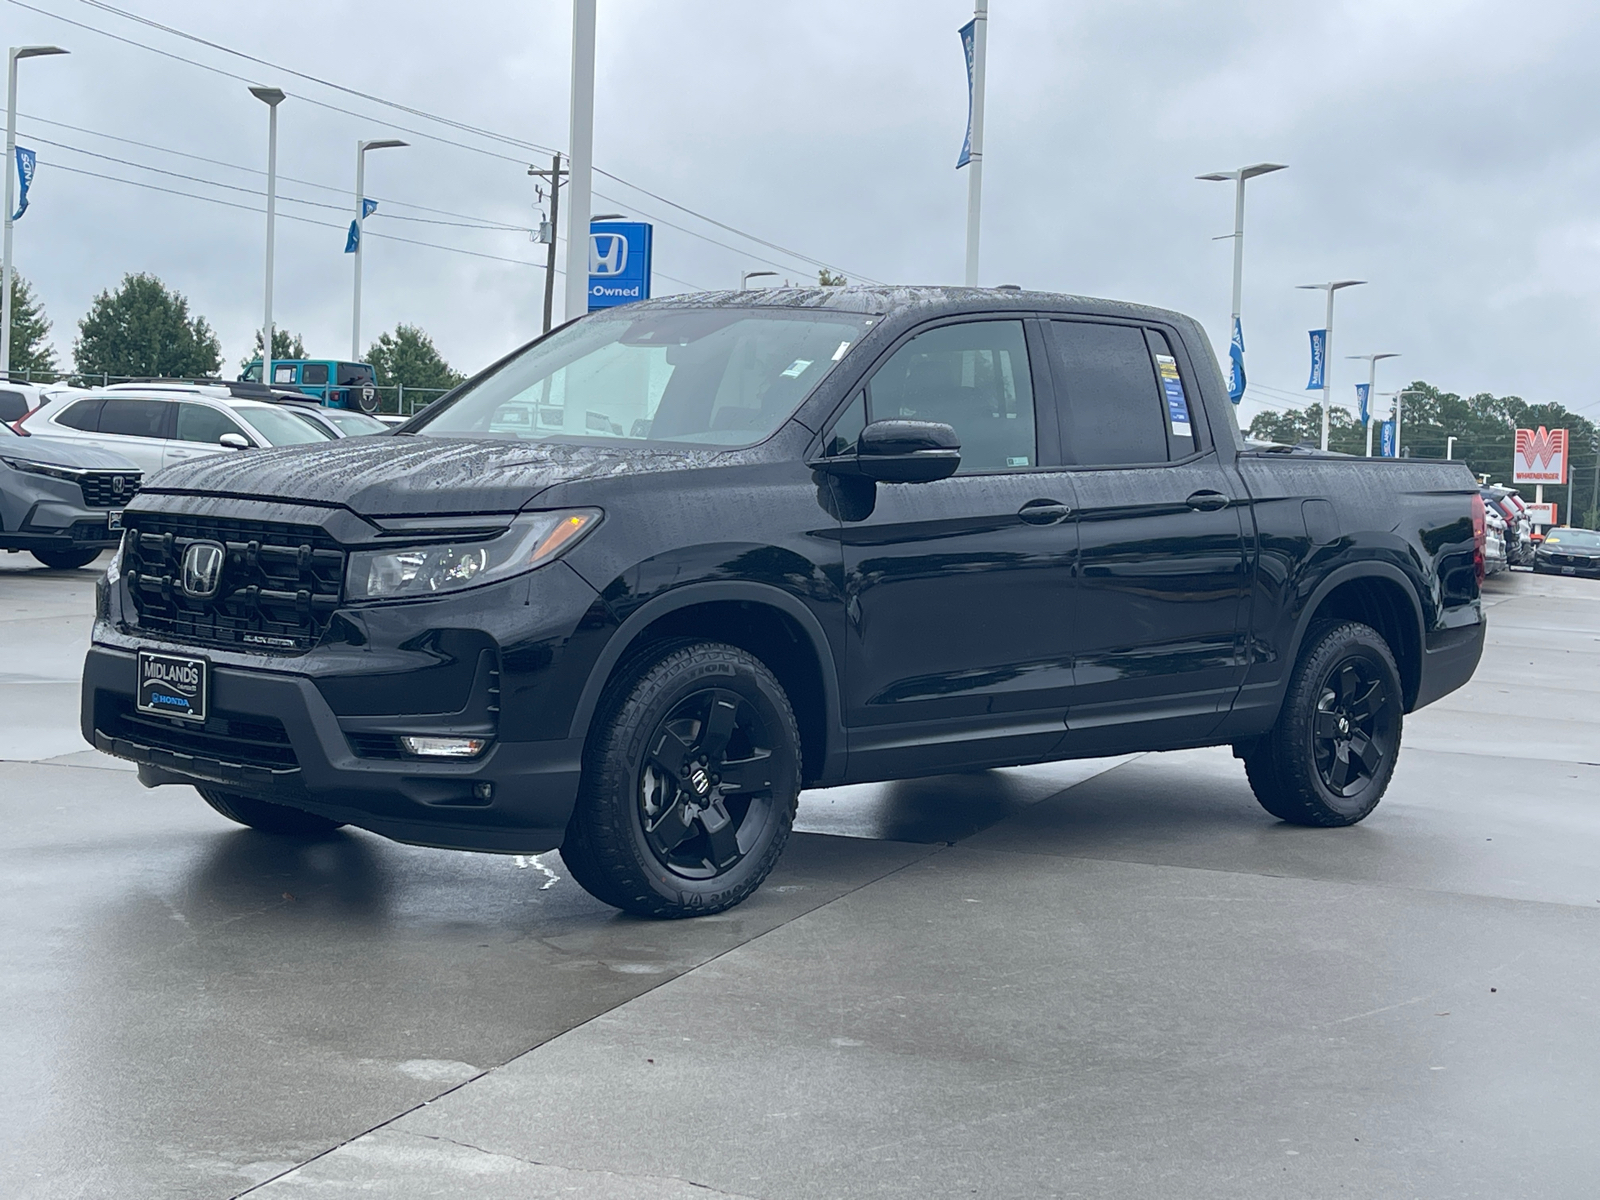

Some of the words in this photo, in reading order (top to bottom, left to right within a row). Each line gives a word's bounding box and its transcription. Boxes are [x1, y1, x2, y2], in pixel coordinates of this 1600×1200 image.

[1312, 334, 1320, 384] MIDLANDS
[1516, 472, 1559, 480] WHATABURGER
[144, 661, 199, 685] MIDLANDS
[159, 695, 190, 707] HONDA
